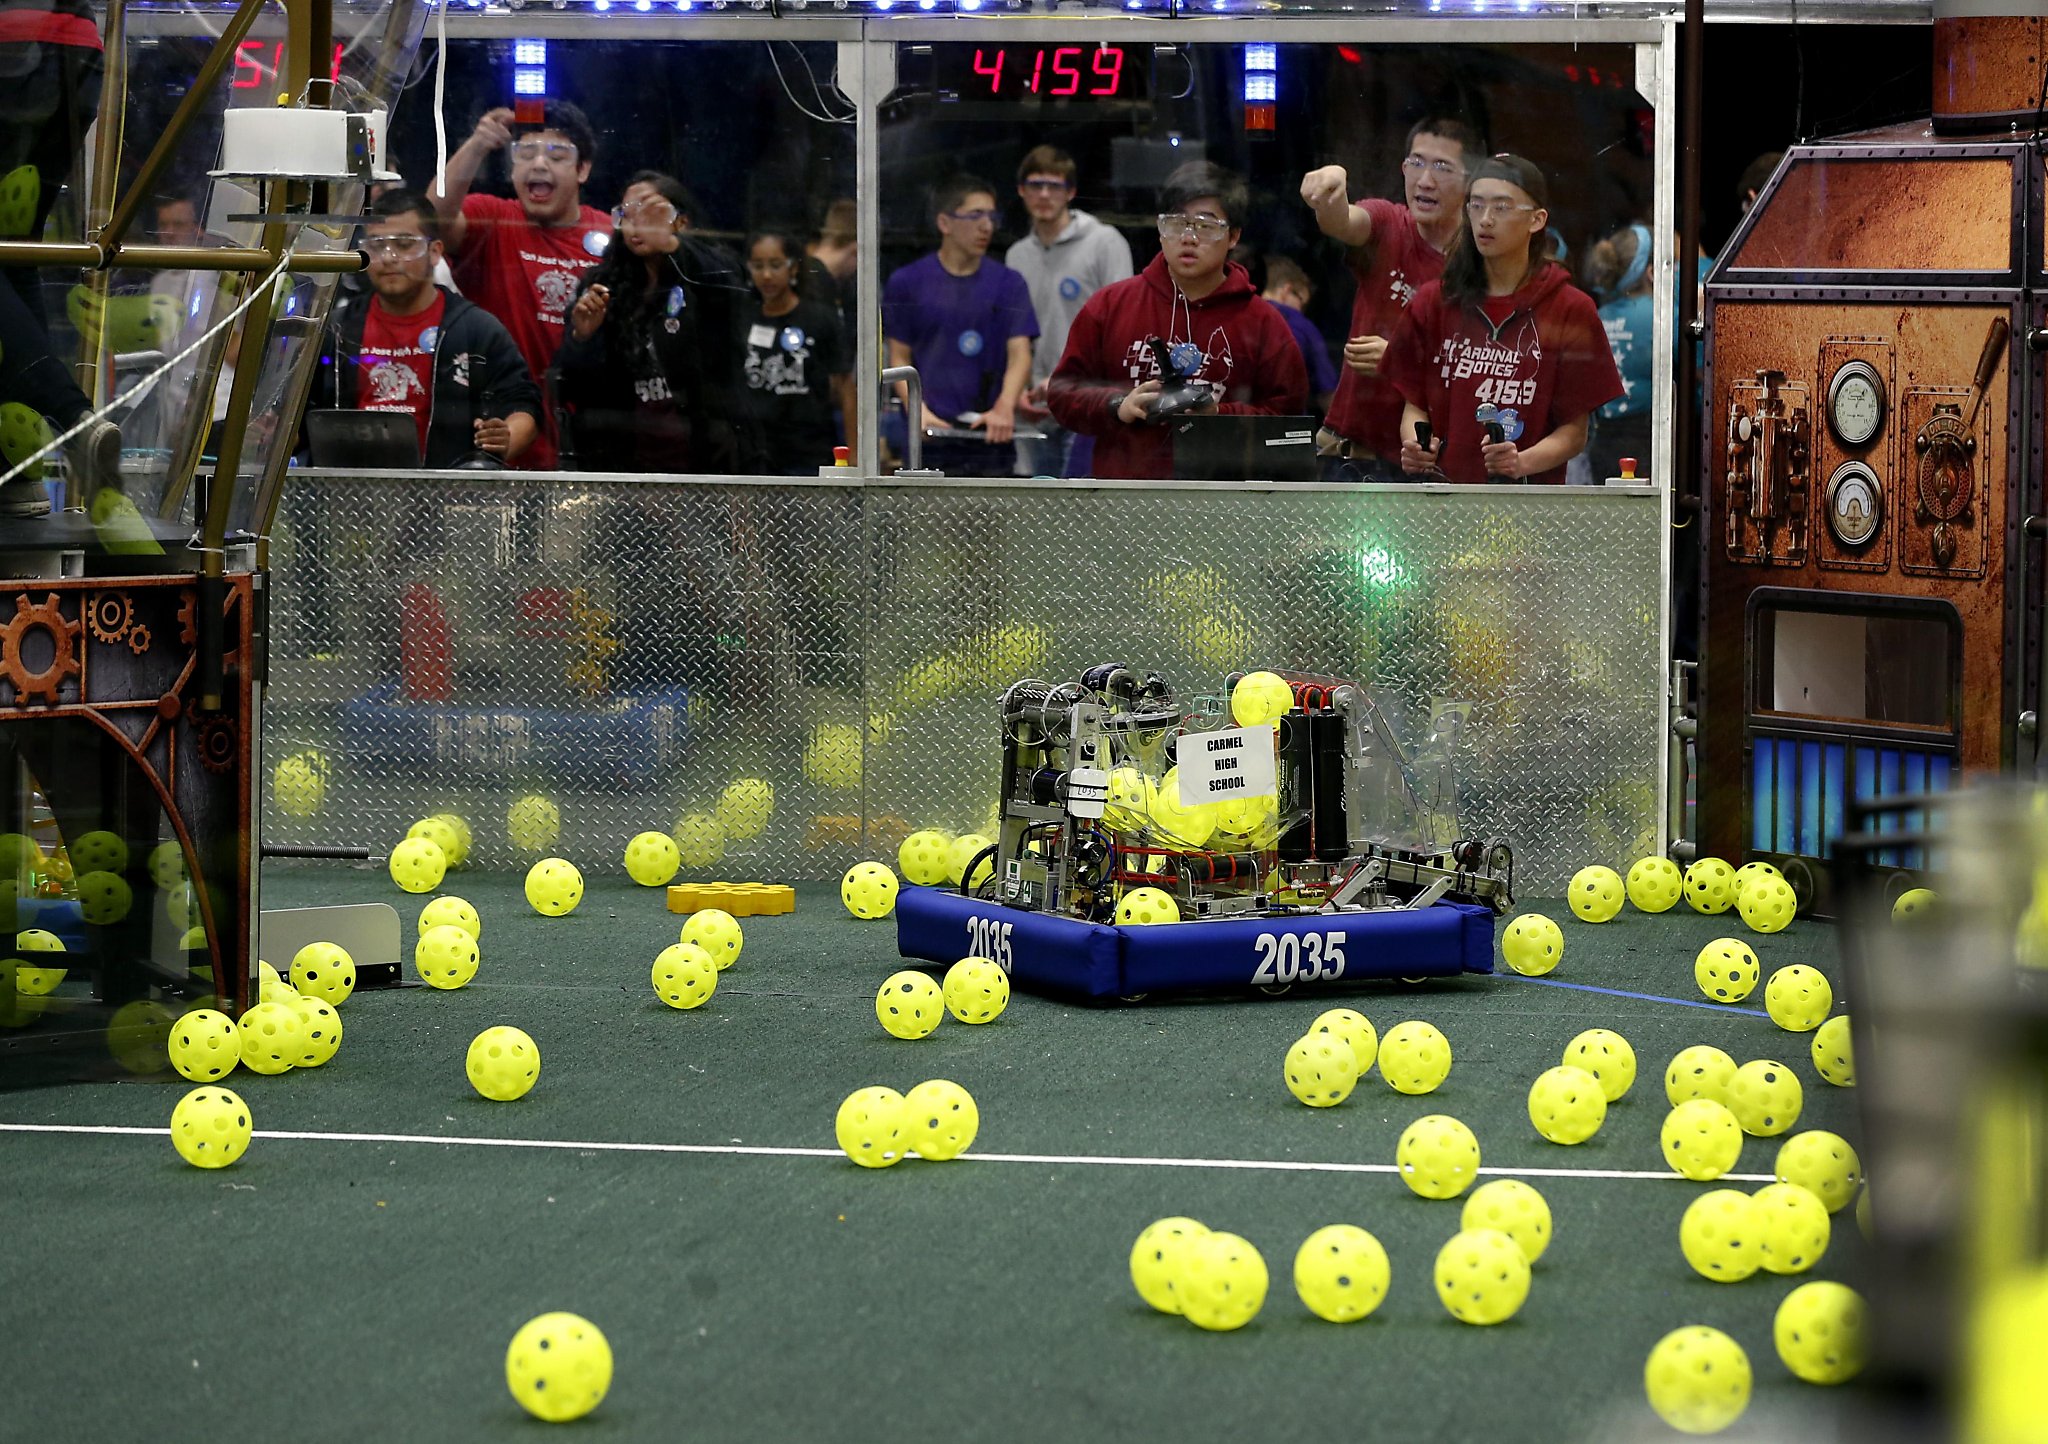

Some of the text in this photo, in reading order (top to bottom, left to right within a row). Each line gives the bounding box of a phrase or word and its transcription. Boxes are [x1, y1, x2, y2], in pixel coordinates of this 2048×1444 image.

[973, 48, 1124, 95] 4159
[360, 347, 369, 355] an
[370, 346, 392, 356] Jose
[1455, 359, 1514, 380] BOTICS
[1474, 378, 1537, 406] 4159
[1929, 419, 1965, 435] ON OFF
[1207, 736, 1244, 752] CARMEL
[1214, 757, 1238, 771] HIGH
[1209, 776, 1245, 792] SCHOOL
[966, 915, 1014, 975] 2035
[1250, 931, 1347, 985] 2035
